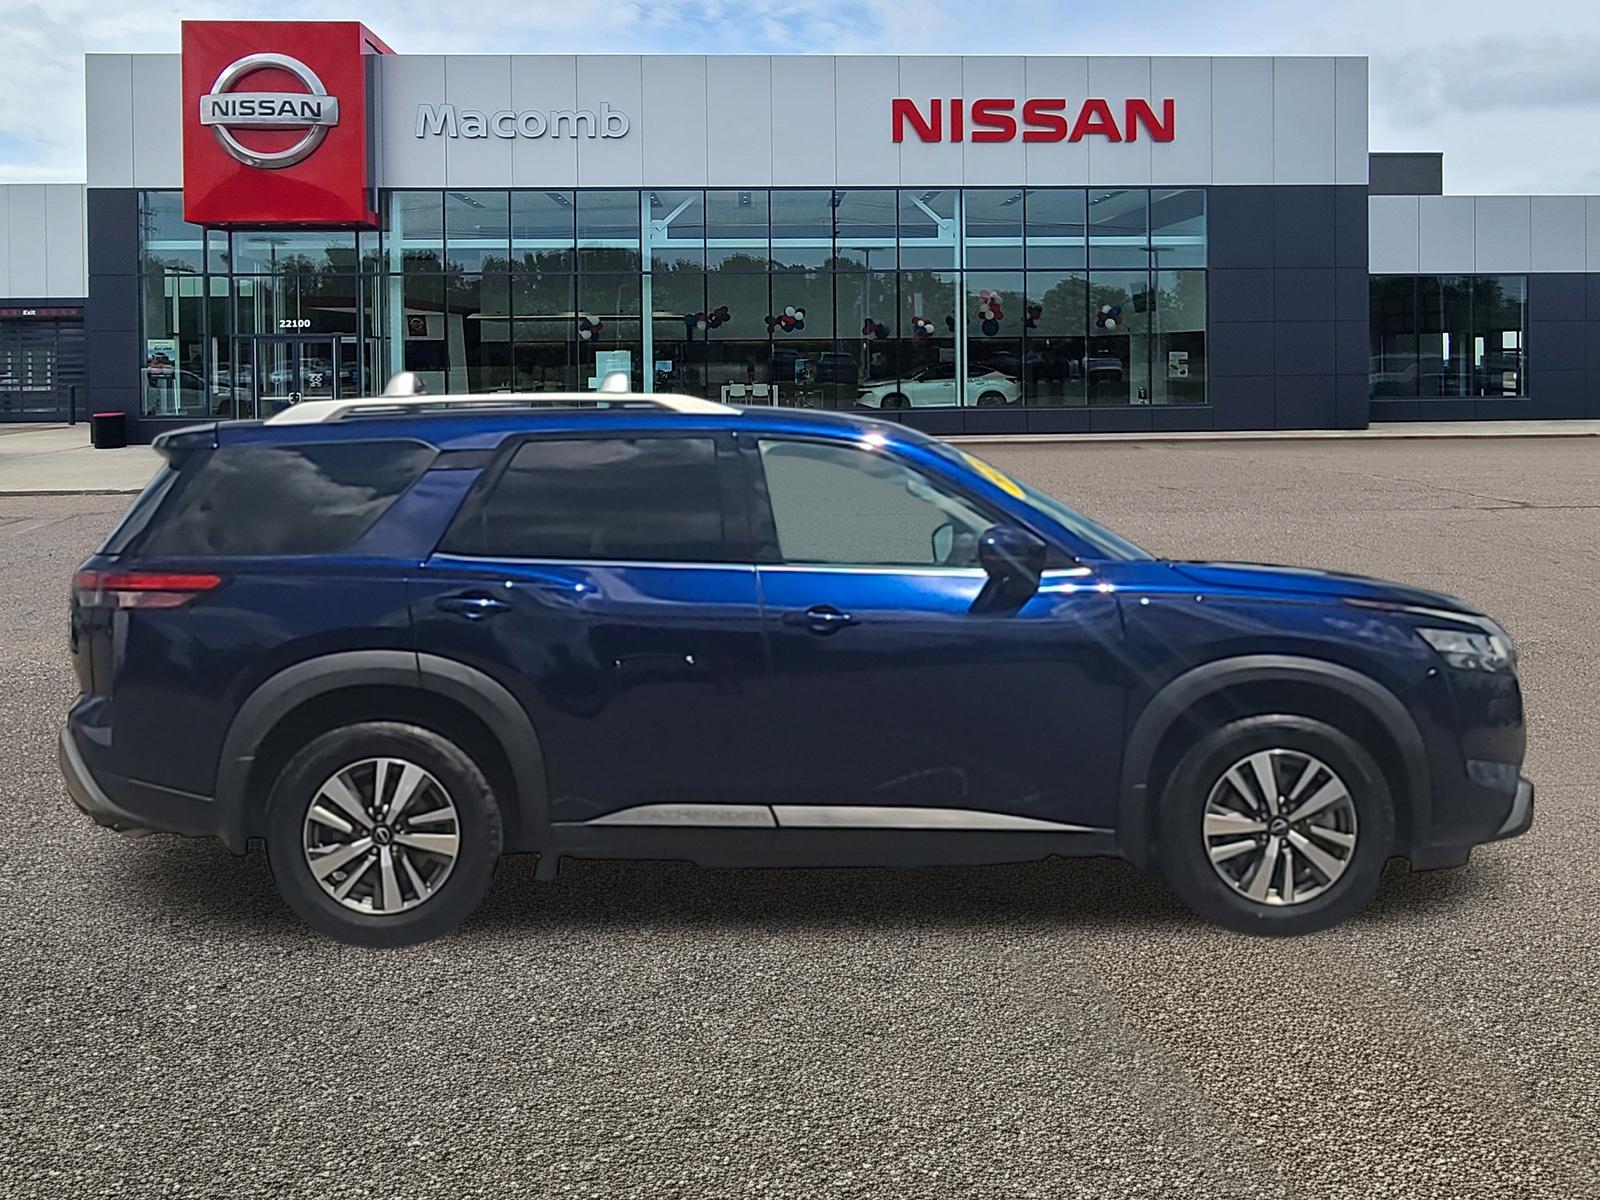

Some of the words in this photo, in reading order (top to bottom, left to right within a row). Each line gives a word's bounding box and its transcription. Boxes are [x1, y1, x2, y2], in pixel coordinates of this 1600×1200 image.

[211, 99, 322, 117] NISSAN
[415, 101, 630, 139] Macomb
[892, 98, 1175, 143] NISSAN
[279, 319, 311, 328] 22100
